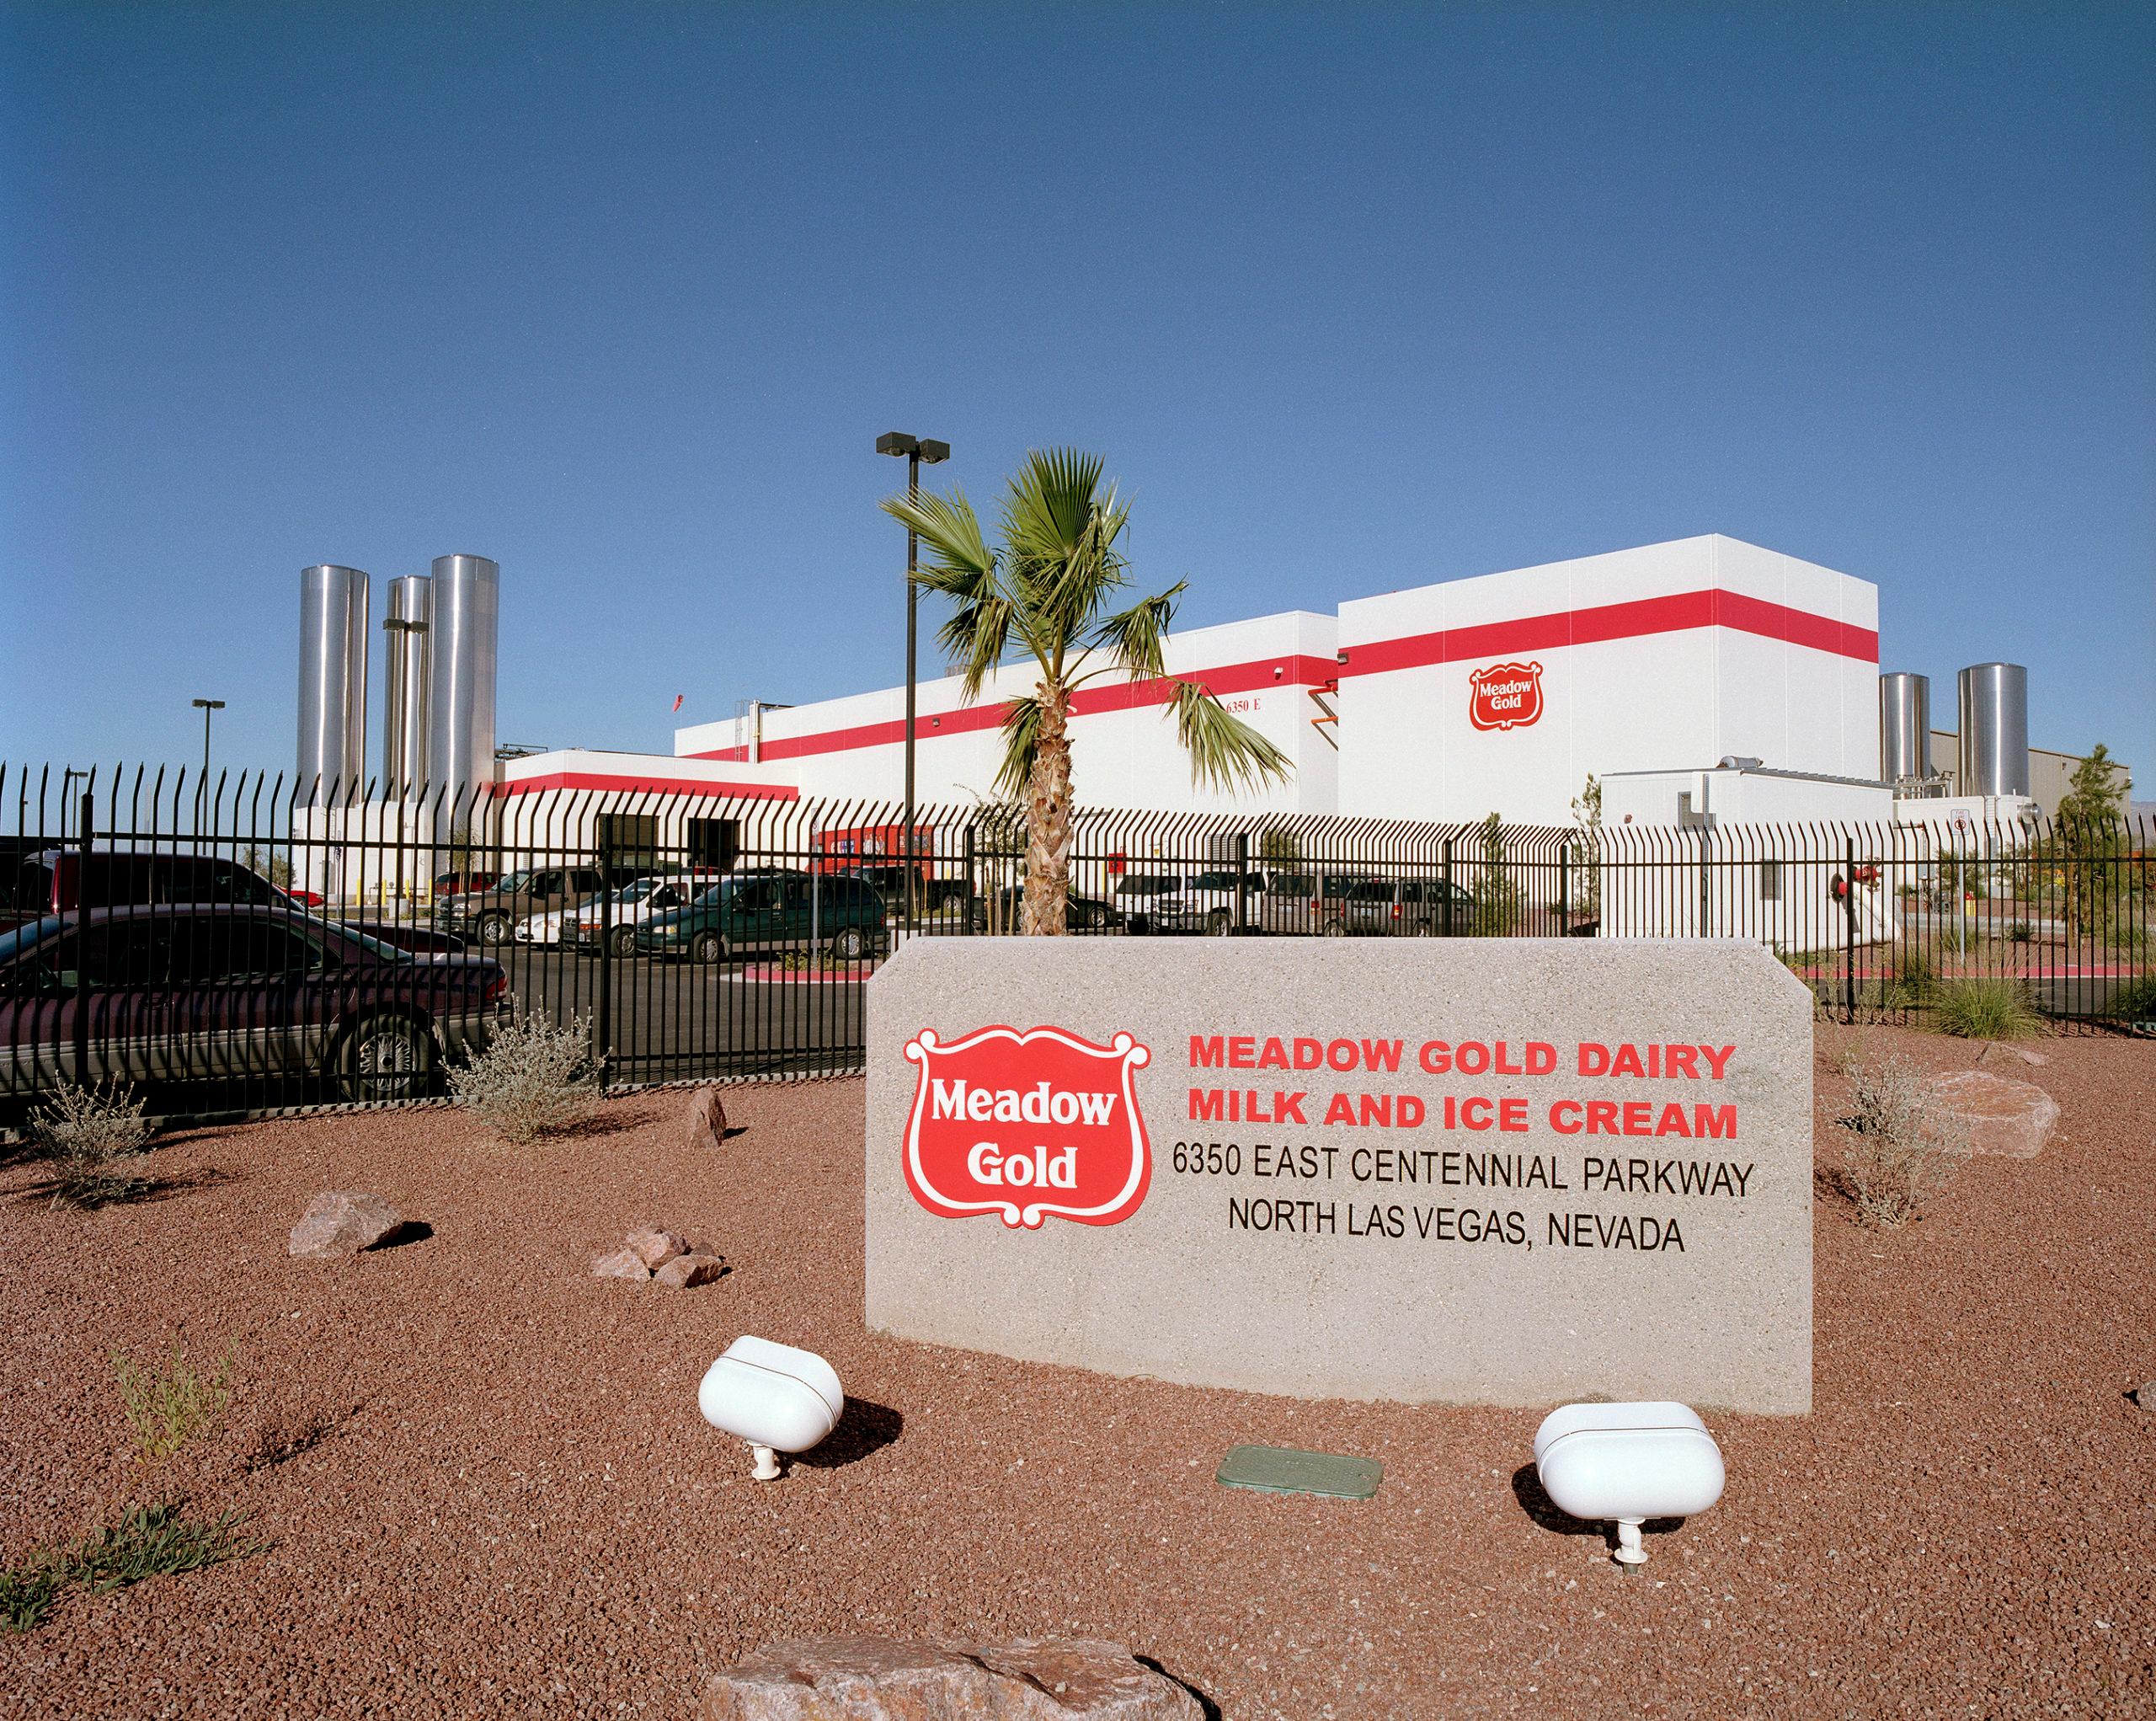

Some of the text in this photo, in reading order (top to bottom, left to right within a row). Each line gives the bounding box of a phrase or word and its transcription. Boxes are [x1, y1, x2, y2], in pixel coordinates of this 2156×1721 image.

[1226, 697, 1261, 714] 6350 E
[1480, 680, 1533, 697] Meadow
[1491, 694, 1522, 710] Gold
[1189, 1035, 1737, 1080] MEADOW GOLD DAIRY
[931, 1078, 1118, 1125] Meadow
[1188, 1088, 1737, 1140] MILK AND ICE CREAM
[967, 1141, 1078, 1189] Gold
[1173, 1141, 1754, 1198] 6350 EAST CENTENNIAL PARKWAY
[1229, 1197, 1685, 1253] NORTH LAS VEGAS, NEVADA
